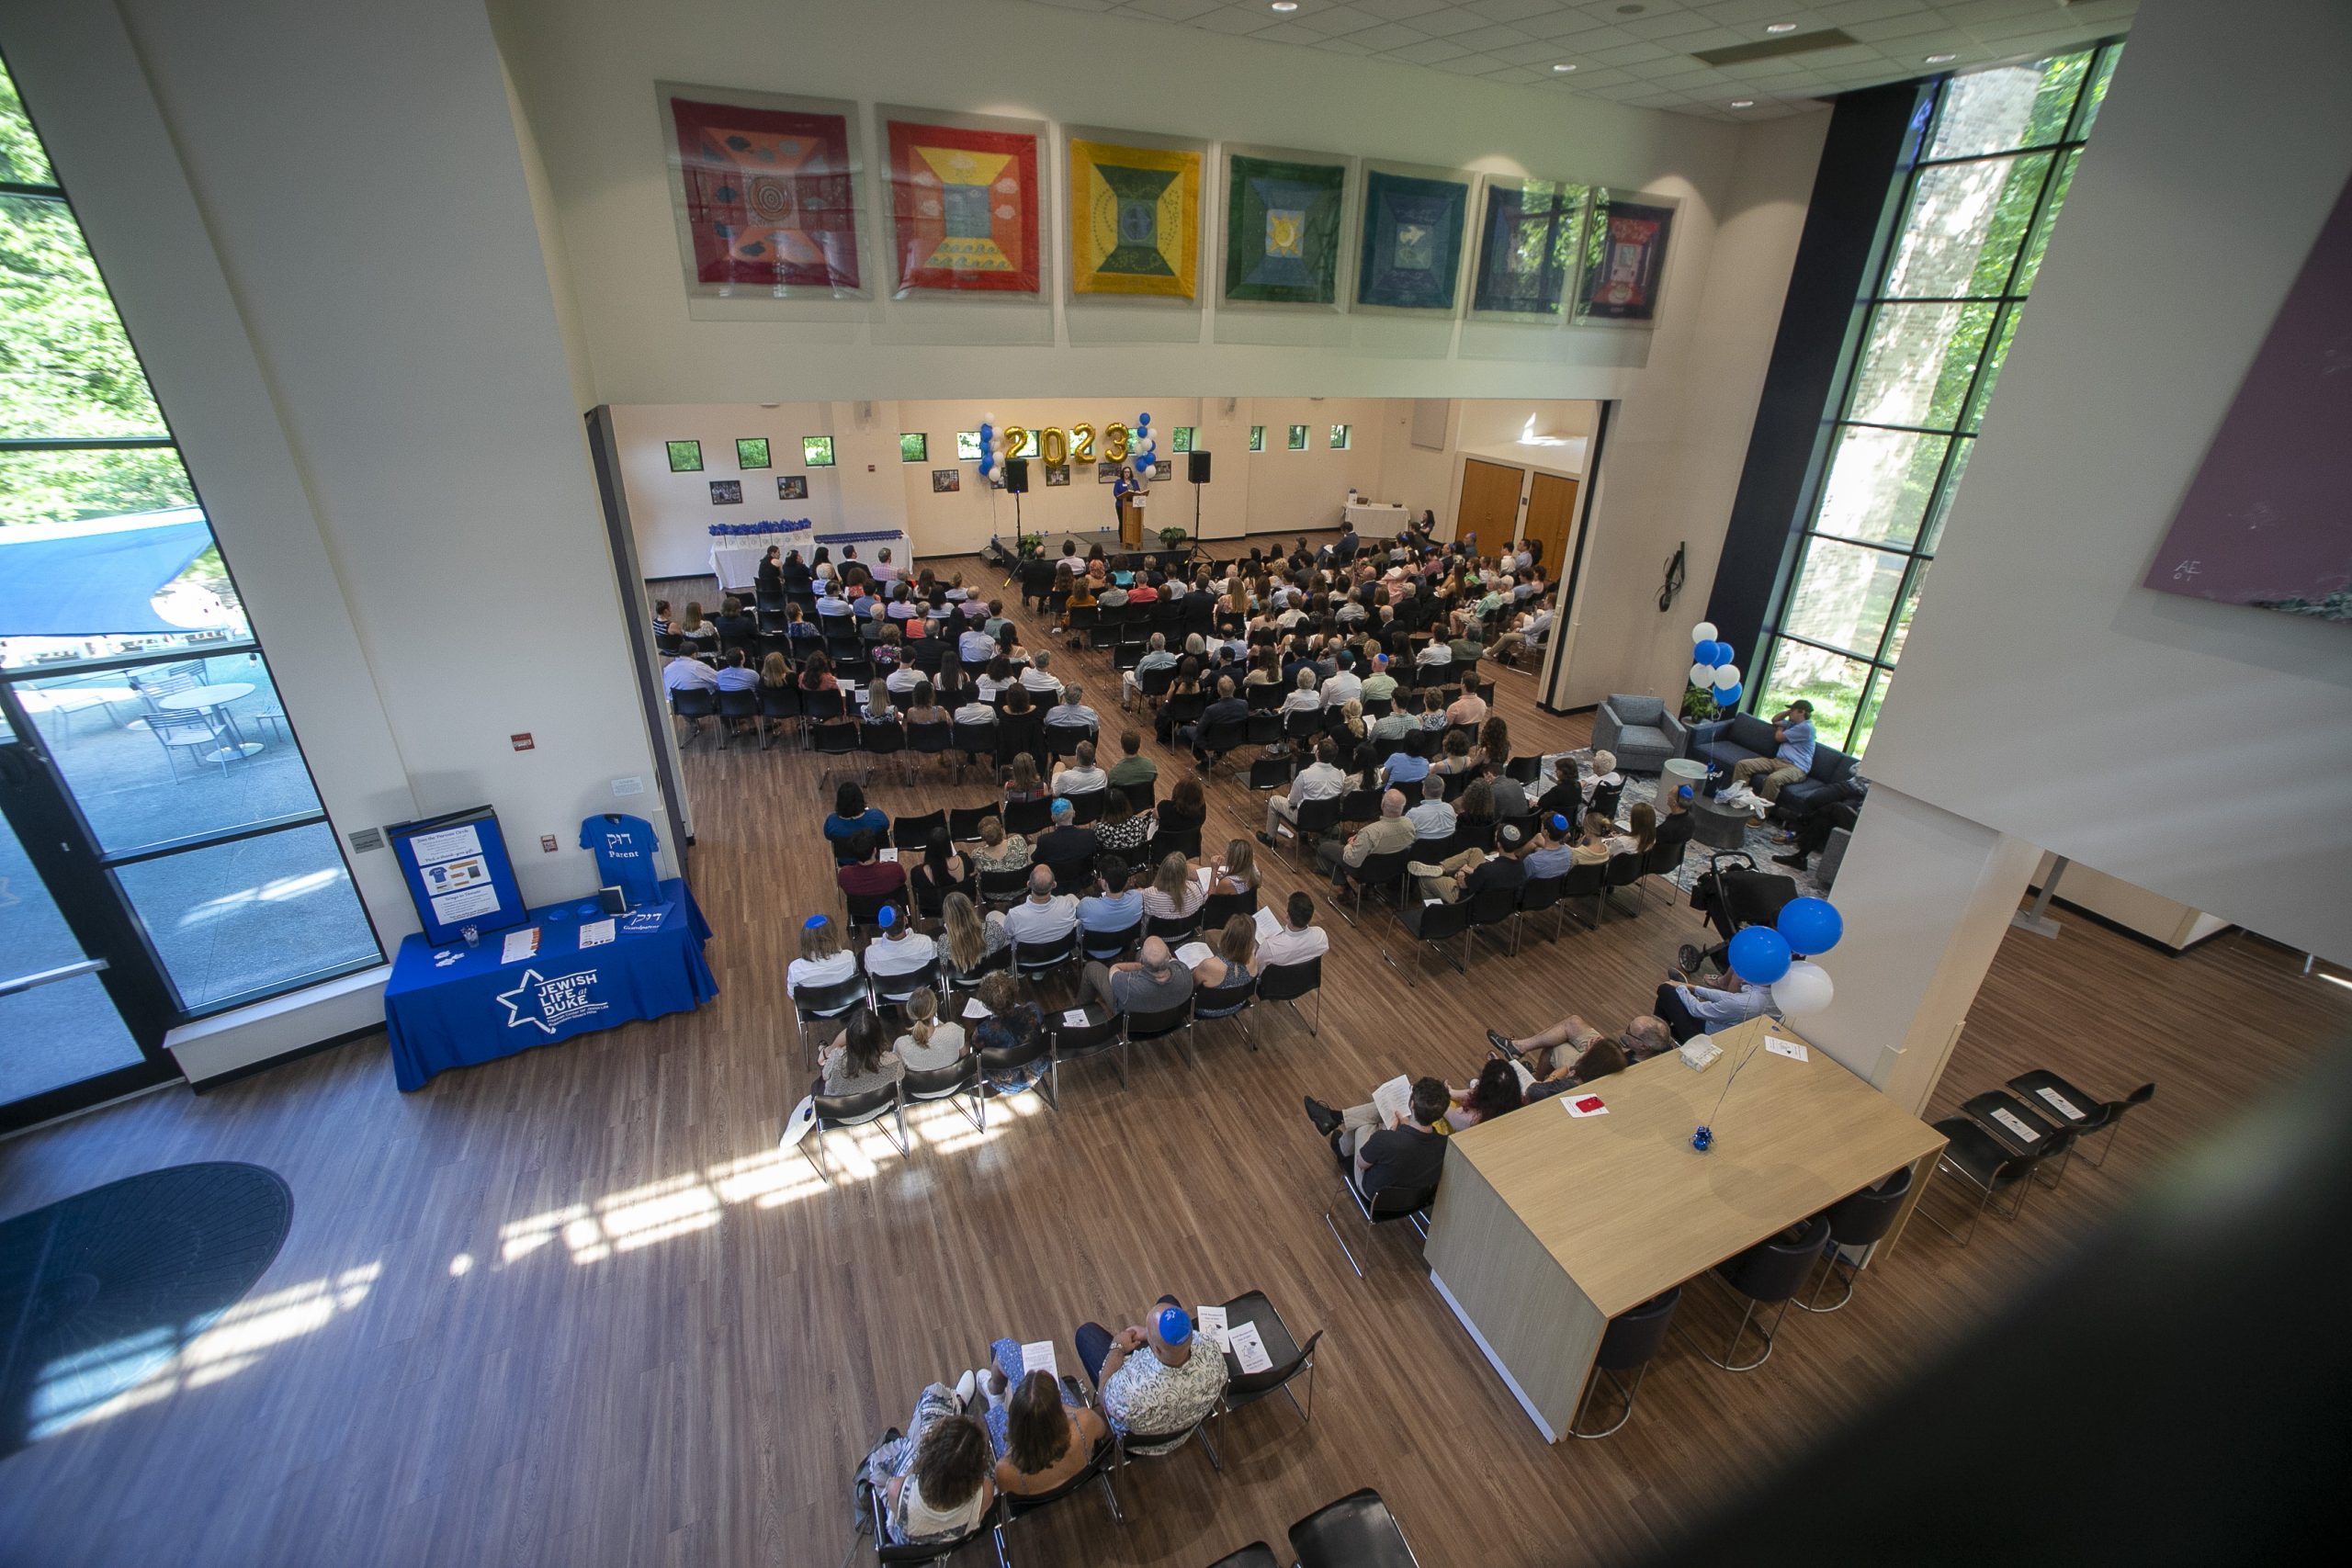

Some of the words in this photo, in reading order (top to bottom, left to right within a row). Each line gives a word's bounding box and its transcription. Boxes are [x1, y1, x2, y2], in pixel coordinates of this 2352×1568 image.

[1004, 423, 1129, 468] 2023
[608, 850, 639, 859] Parent
[537, 974, 597, 997] JEWISH
[540, 988, 576, 1007] LIFE
[578, 987, 587, 996] at
[544, 995, 588, 1016] DUKE
